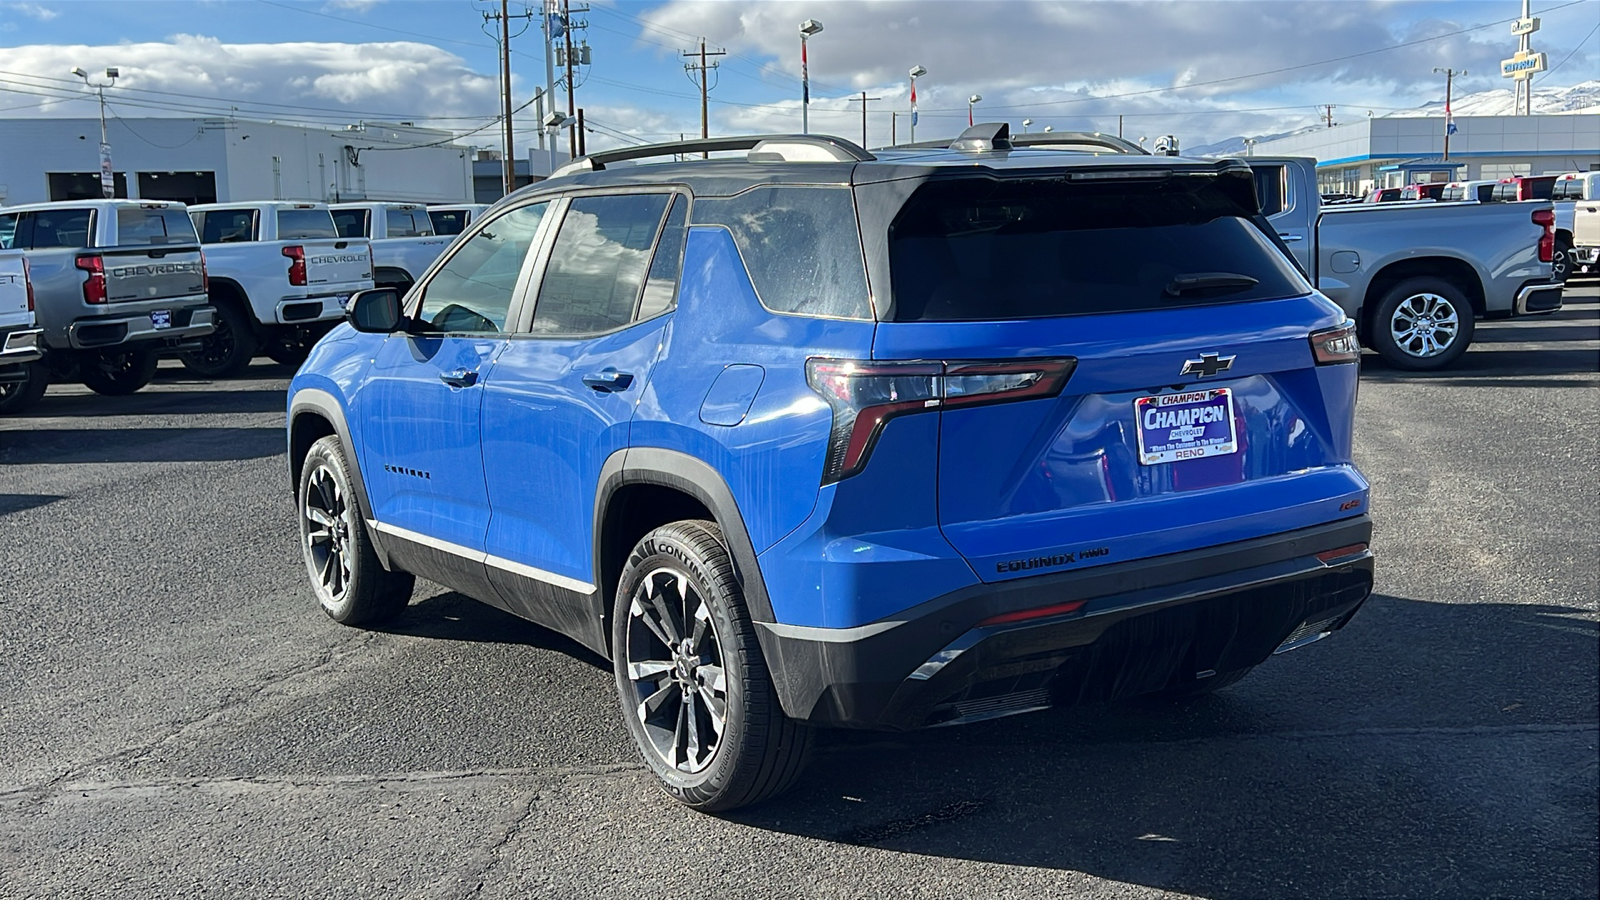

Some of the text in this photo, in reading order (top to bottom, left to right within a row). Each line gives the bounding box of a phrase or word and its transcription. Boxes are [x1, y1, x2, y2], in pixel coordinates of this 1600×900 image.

[311, 254, 367, 264] CHEVROLET
[113, 263, 199, 277] CHEVROLET
[1162, 392, 1206, 405] CHAMPION
[1144, 405, 1224, 430] CHAMPION
[1171, 427, 1203, 438] CHEVROLET
[1176, 448, 1204, 459] RENO
[996, 547, 1110, 573] EQUINOX AWD
